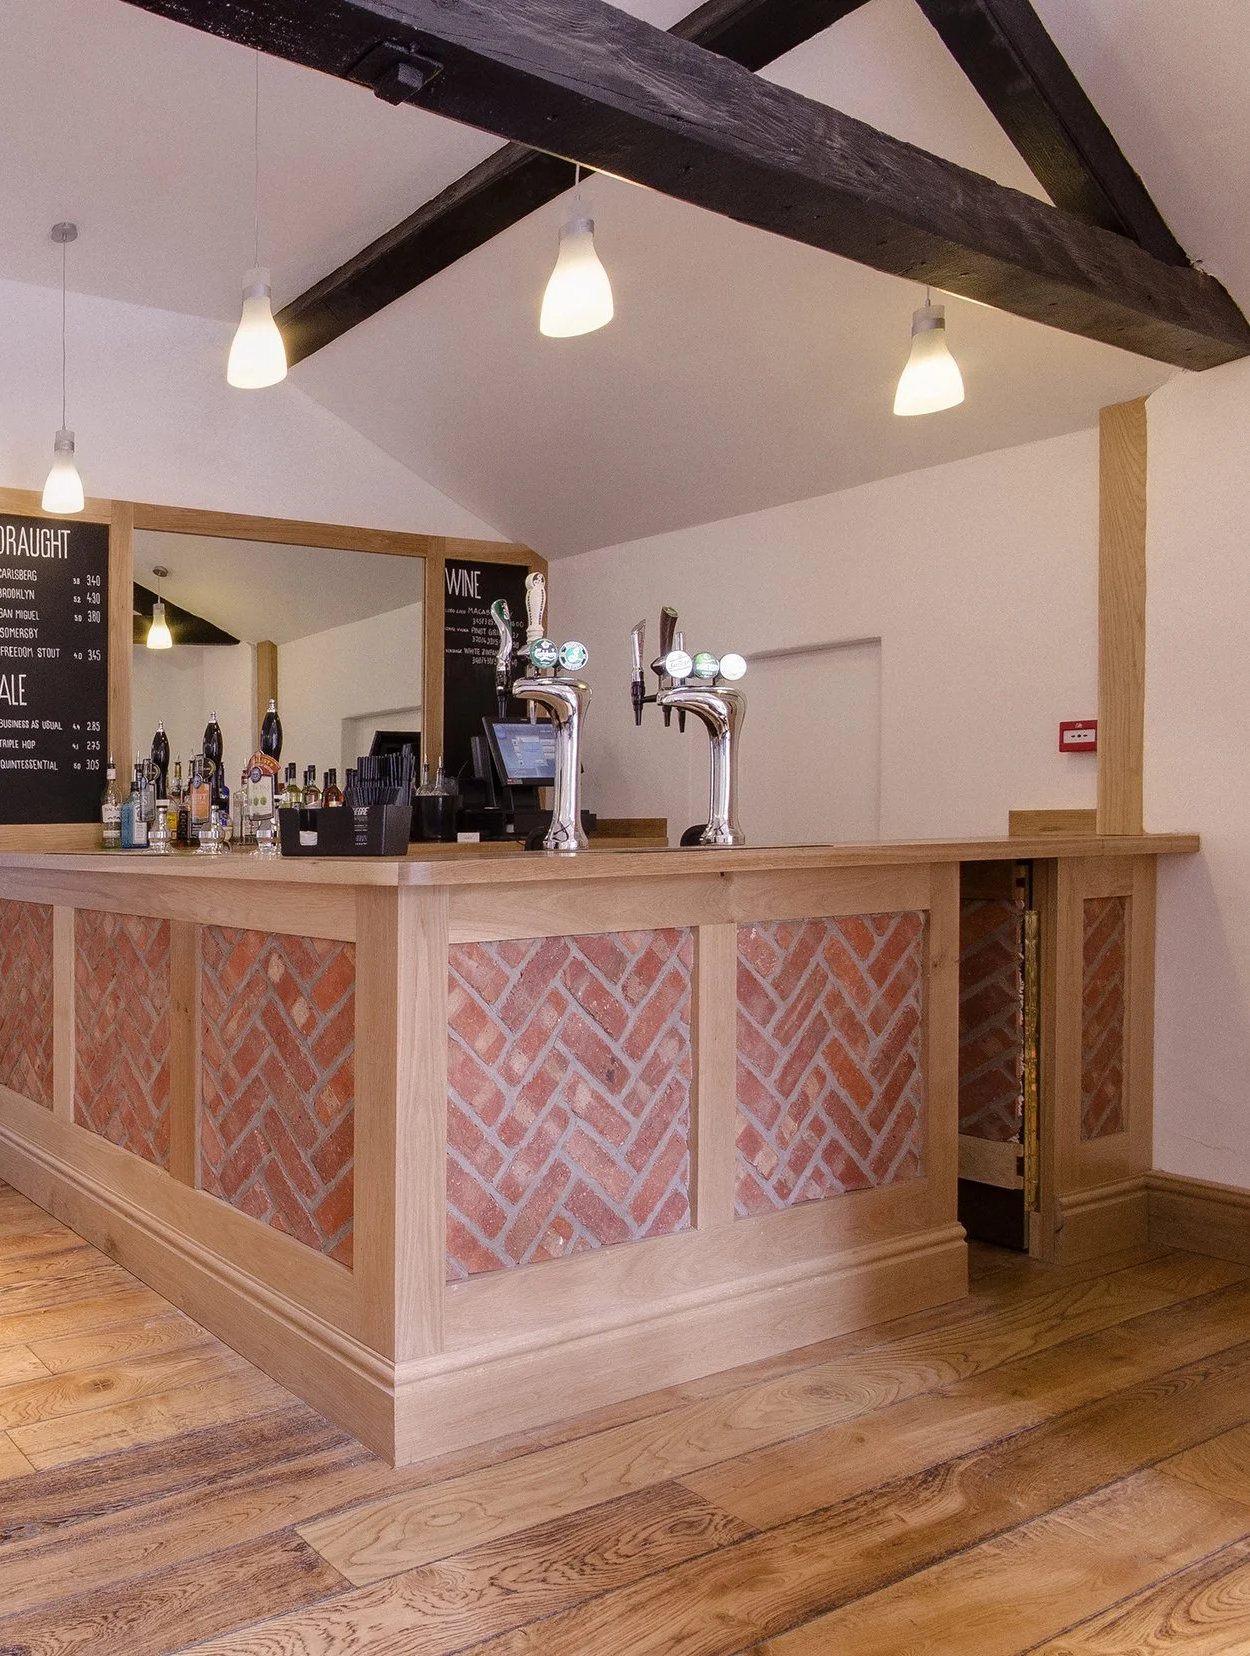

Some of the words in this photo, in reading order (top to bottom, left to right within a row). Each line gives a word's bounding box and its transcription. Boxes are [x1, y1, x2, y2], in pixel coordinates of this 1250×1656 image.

[445, 568, 482, 599] WINE
[15, 609, 40, 621] MIGUEL
[0, 628, 39, 639] SOMERSBY
[471, 627, 486, 635] PINOT
[0, 646, 34, 658] FREEDOM
[37, 648, 61, 658] STOUT
[464, 647, 481, 655] WHITE
[31, 719, 39, 729] AS
[41, 720, 63, 731] USUAL
[21, 740, 36, 749] HOP
[0, 759, 59, 771] QUINTESSENTIAL
